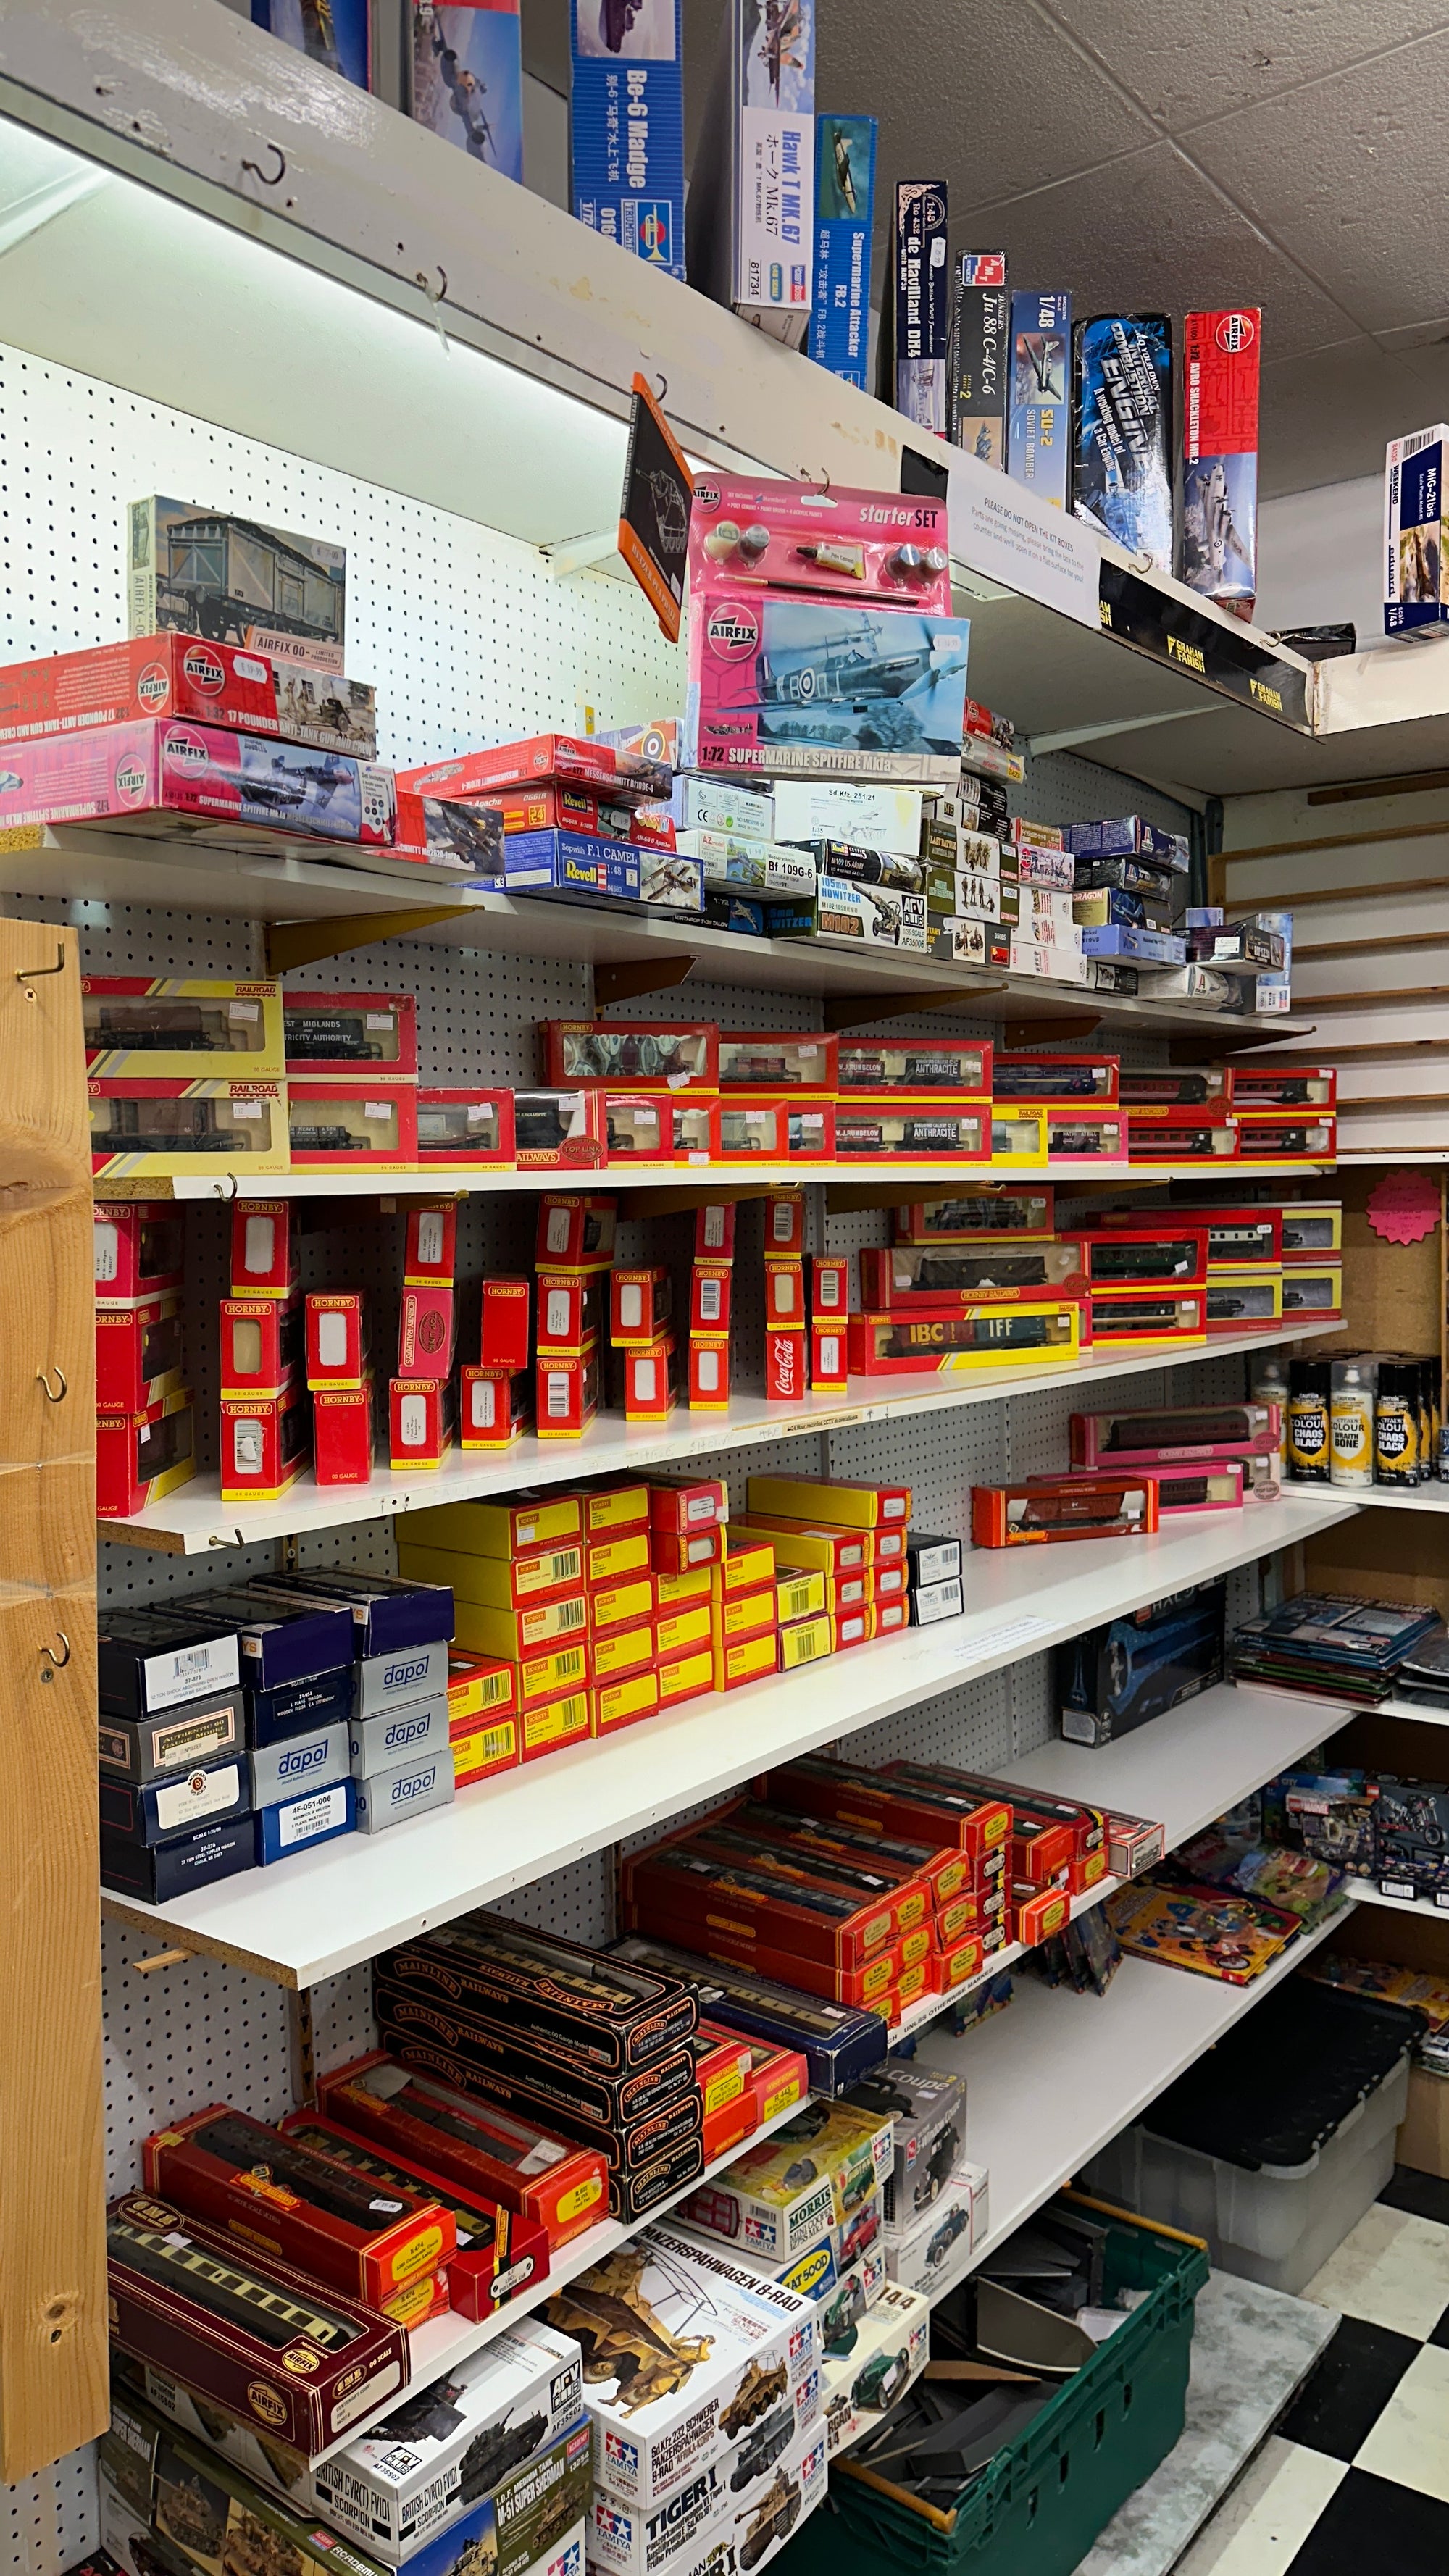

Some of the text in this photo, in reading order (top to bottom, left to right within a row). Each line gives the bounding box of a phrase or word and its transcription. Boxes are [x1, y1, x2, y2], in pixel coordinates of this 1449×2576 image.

[626, 70, 648, 188] Be-6 Madge
[767, 134, 779, 181] ホーク
[782, 130, 801, 173] Hawk
[782, 193, 800, 245] MK.67
[927, 201, 938, 222] 1:48
[750, 262, 759, 296] 81734
[835, 285, 848, 308] FB.2
[848, 232, 865, 358] Supermarine Attacker
[907, 237, 922, 359] de Havilland DH4
[1037, 296, 1055, 328] 1/48
[1230, 317, 1240, 351] AIRFIX
[1111, 321, 1151, 417] COMBUSTION
[1095, 395, 1122, 446] working model
[1101, 357, 1155, 472] ENGINE
[1188, 362, 1200, 465] AVRO SHACKLETON MR.2
[1040, 409, 1054, 447] SU-2
[1024, 409, 1036, 479] SOVIET BOMBER
[693, 490, 719, 500] AIRFIX
[1426, 467, 1437, 519] MiG-21bis
[972, 506, 985, 521] Parts
[984, 498, 1074, 553] PLEASE DO NOT OPEN THE KIT BOXES
[710, 624, 756, 641] AIRFIX
[256, 637, 291, 655] AIRFIX
[1177, 640, 1203, 661] GRAHAM
[185, 661, 224, 680] AIRFIX
[311, 654, 338, 666] PRODUCTION
[1177, 650, 1206, 674] FARISH
[139, 680, 167, 695] AIRFIX
[1257, 682, 1281, 701] GRAHAM
[1258, 691, 1283, 712] FARISH
[227, 710, 373, 756] 17 POUNDER ANTI-TANK GUN AND CREW
[167, 743, 206, 758] AIRFIX
[701, 746, 724, 761] 1:72
[728, 748, 810, 767] SUPERMARINE
[811, 753, 861, 769] SPITFIRE
[117, 772, 145, 787] AIRFIX
[584, 769, 630, 787] MESSERSCHMITT
[199, 795, 241, 812] SUPERMARINE
[562, 791, 588, 810] Revell
[561, 842, 585, 856] Sopwith
[603, 848, 638, 865] CAMEL
[566, 861, 598, 884] Revell
[607, 864, 622, 877] 1:48
[768, 861, 813, 879] Bf 109G-6
[820, 877, 848, 890] 105mm
[1072, 890, 1104, 900] DRAGON
[821, 888, 861, 904] HOWITZER
[822, 912, 860, 935] M102
[235, 985, 276, 995] RAILROAD
[303, 1020, 341, 1029] MIDLANDS
[312, 1033, 351, 1042] AUTHORITY
[915, 1063, 958, 1076] ANTHRACITE
[230, 1084, 278, 1094] RAILROAD
[914, 1126, 956, 1139] ANTHRACITE
[580, 1145, 601, 1154] LINK
[241, 1202, 280, 1212] HORNBY
[546, 1196, 577, 1207] HORNBY
[491, 1286, 524, 1297] HORNBY
[229, 1304, 269, 1314] HORNBY
[314, 1299, 353, 1309] HORNBY
[909, 1322, 944, 1345] IBC
[397, 1382, 433, 1393] HORNBY
[230, 1404, 271, 1414] HORNBY
[323, 1394, 362, 1405] HORNBY
[1295, 1429, 1324, 1438] CHAOS
[1295, 1438, 1324, 1447] BLACK
[1335, 1431, 1358, 1441] WRAITH
[384, 1655, 430, 1685] dapol
[385, 1713, 431, 1744] dapol
[278, 1739, 329, 1774] dapol
[391, 1766, 436, 1799] dapol
[292, 1795, 332, 1814] 4F-051-006
[399, 1960, 509, 2004] MAINLINE RAILWAYS
[928, 1987, 966, 2016] OTHERWISE
[967, 1966, 994, 1989] MARKED
[457, 2027, 504, 2054] RAILWAYS
[634, 2020, 666, 2042] MAINLINE
[465, 2070, 512, 2099] RAILWAYS
[626, 2055, 687, 2099] MAINLINE RAILWAYS
[887, 2069, 951, 2091] Coupe
[634, 2121, 668, 2146] MAINLINE
[789, 2188, 832, 2229] MORRIS
[789, 2207, 833, 2244] MINI COOPER
[746, 2236, 776, 2251] TAMIYA
[803, 2254, 828, 2283] 500D
[756, 2284, 803, 2312] 8-RAD
[287, 2352, 315, 2371] AIRFIX
[377, 2348, 393, 2362] SCALE
[251, 2391, 285, 2418] AIRFIX
[686, 2397, 720, 2434] SCHWERER
[317, 2464, 343, 2488] BRITISH
[513, 2455, 554, 2492] MEDIUM TANK
[606, 2454, 638, 2477] TAMIYA
[652, 2460, 674, 2483] 8-RAD
[401, 2480, 443, 2524] BRITISH CVR(T)
[497, 2459, 565, 2527] M-51 SUPER SHERMAN
[334, 2494, 370, 2526] SCORPION
[417, 2497, 446, 2528] SCORPION
[646, 2475, 709, 2541] TIGER
[597, 2527, 632, 2551] TAMIYA
